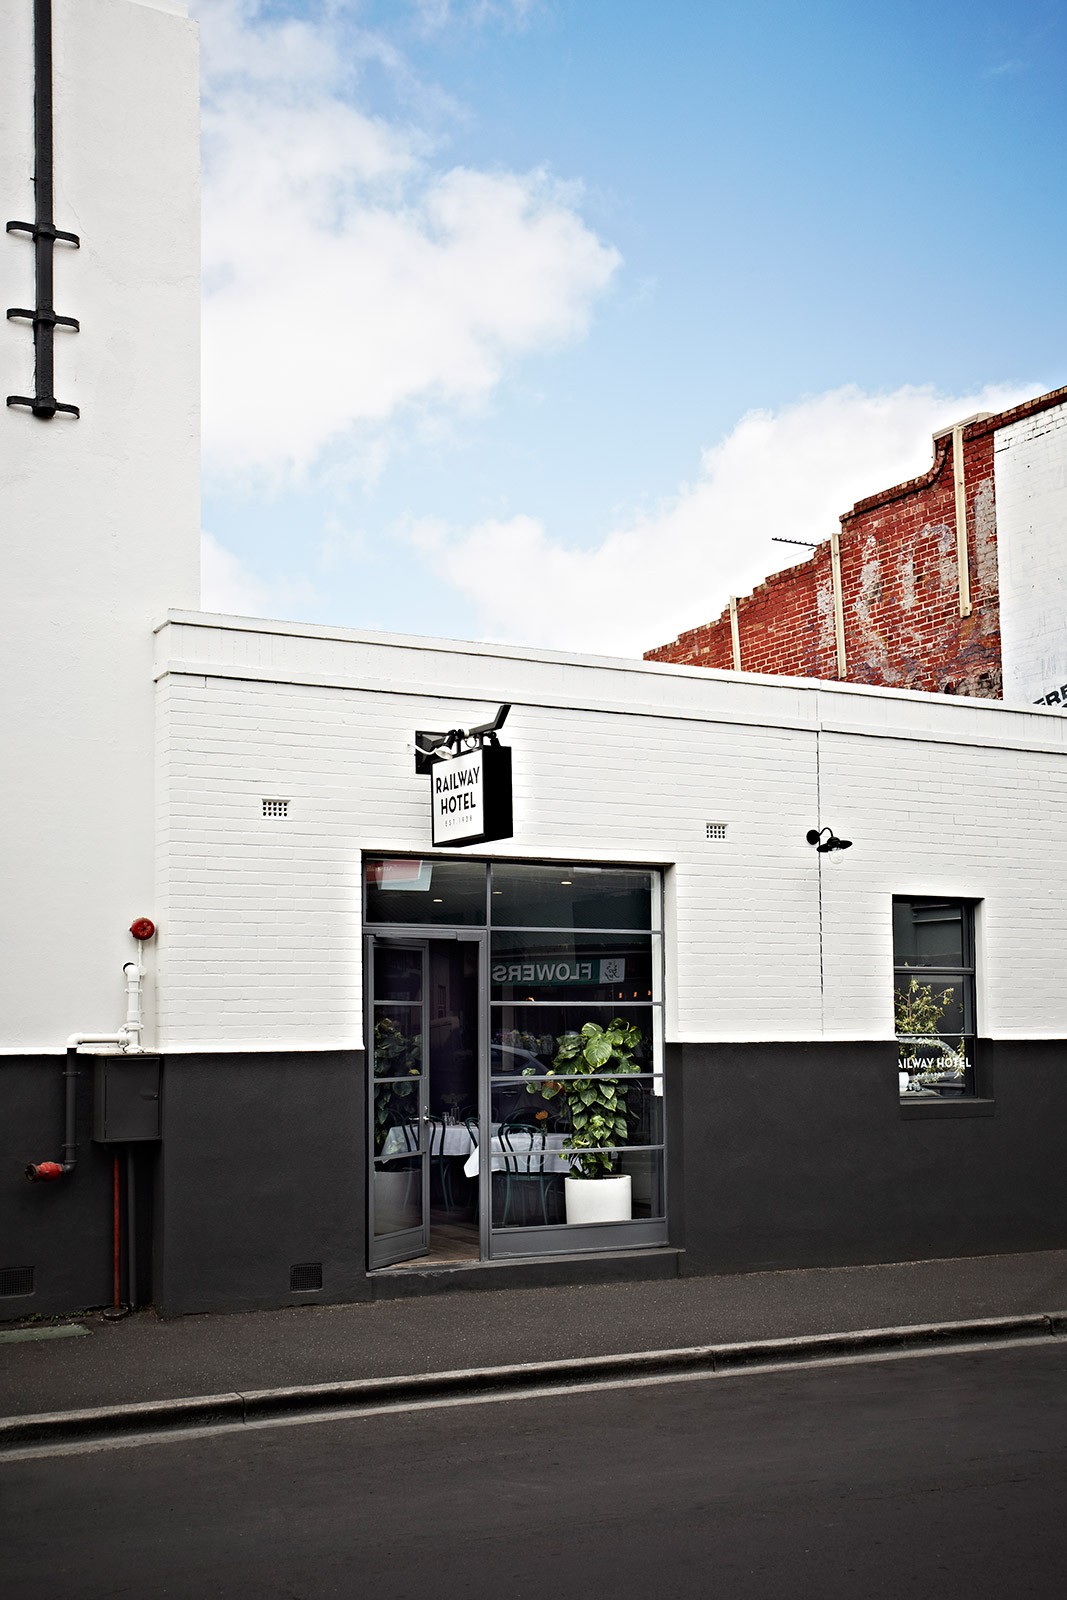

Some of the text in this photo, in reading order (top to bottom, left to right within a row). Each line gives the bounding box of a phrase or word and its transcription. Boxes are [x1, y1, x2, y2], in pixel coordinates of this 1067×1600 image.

[436, 766, 480, 794] RAILWAY
[441, 791, 476, 815] HOTEL
[898, 1057, 972, 1068] AILWAY HOTEL
